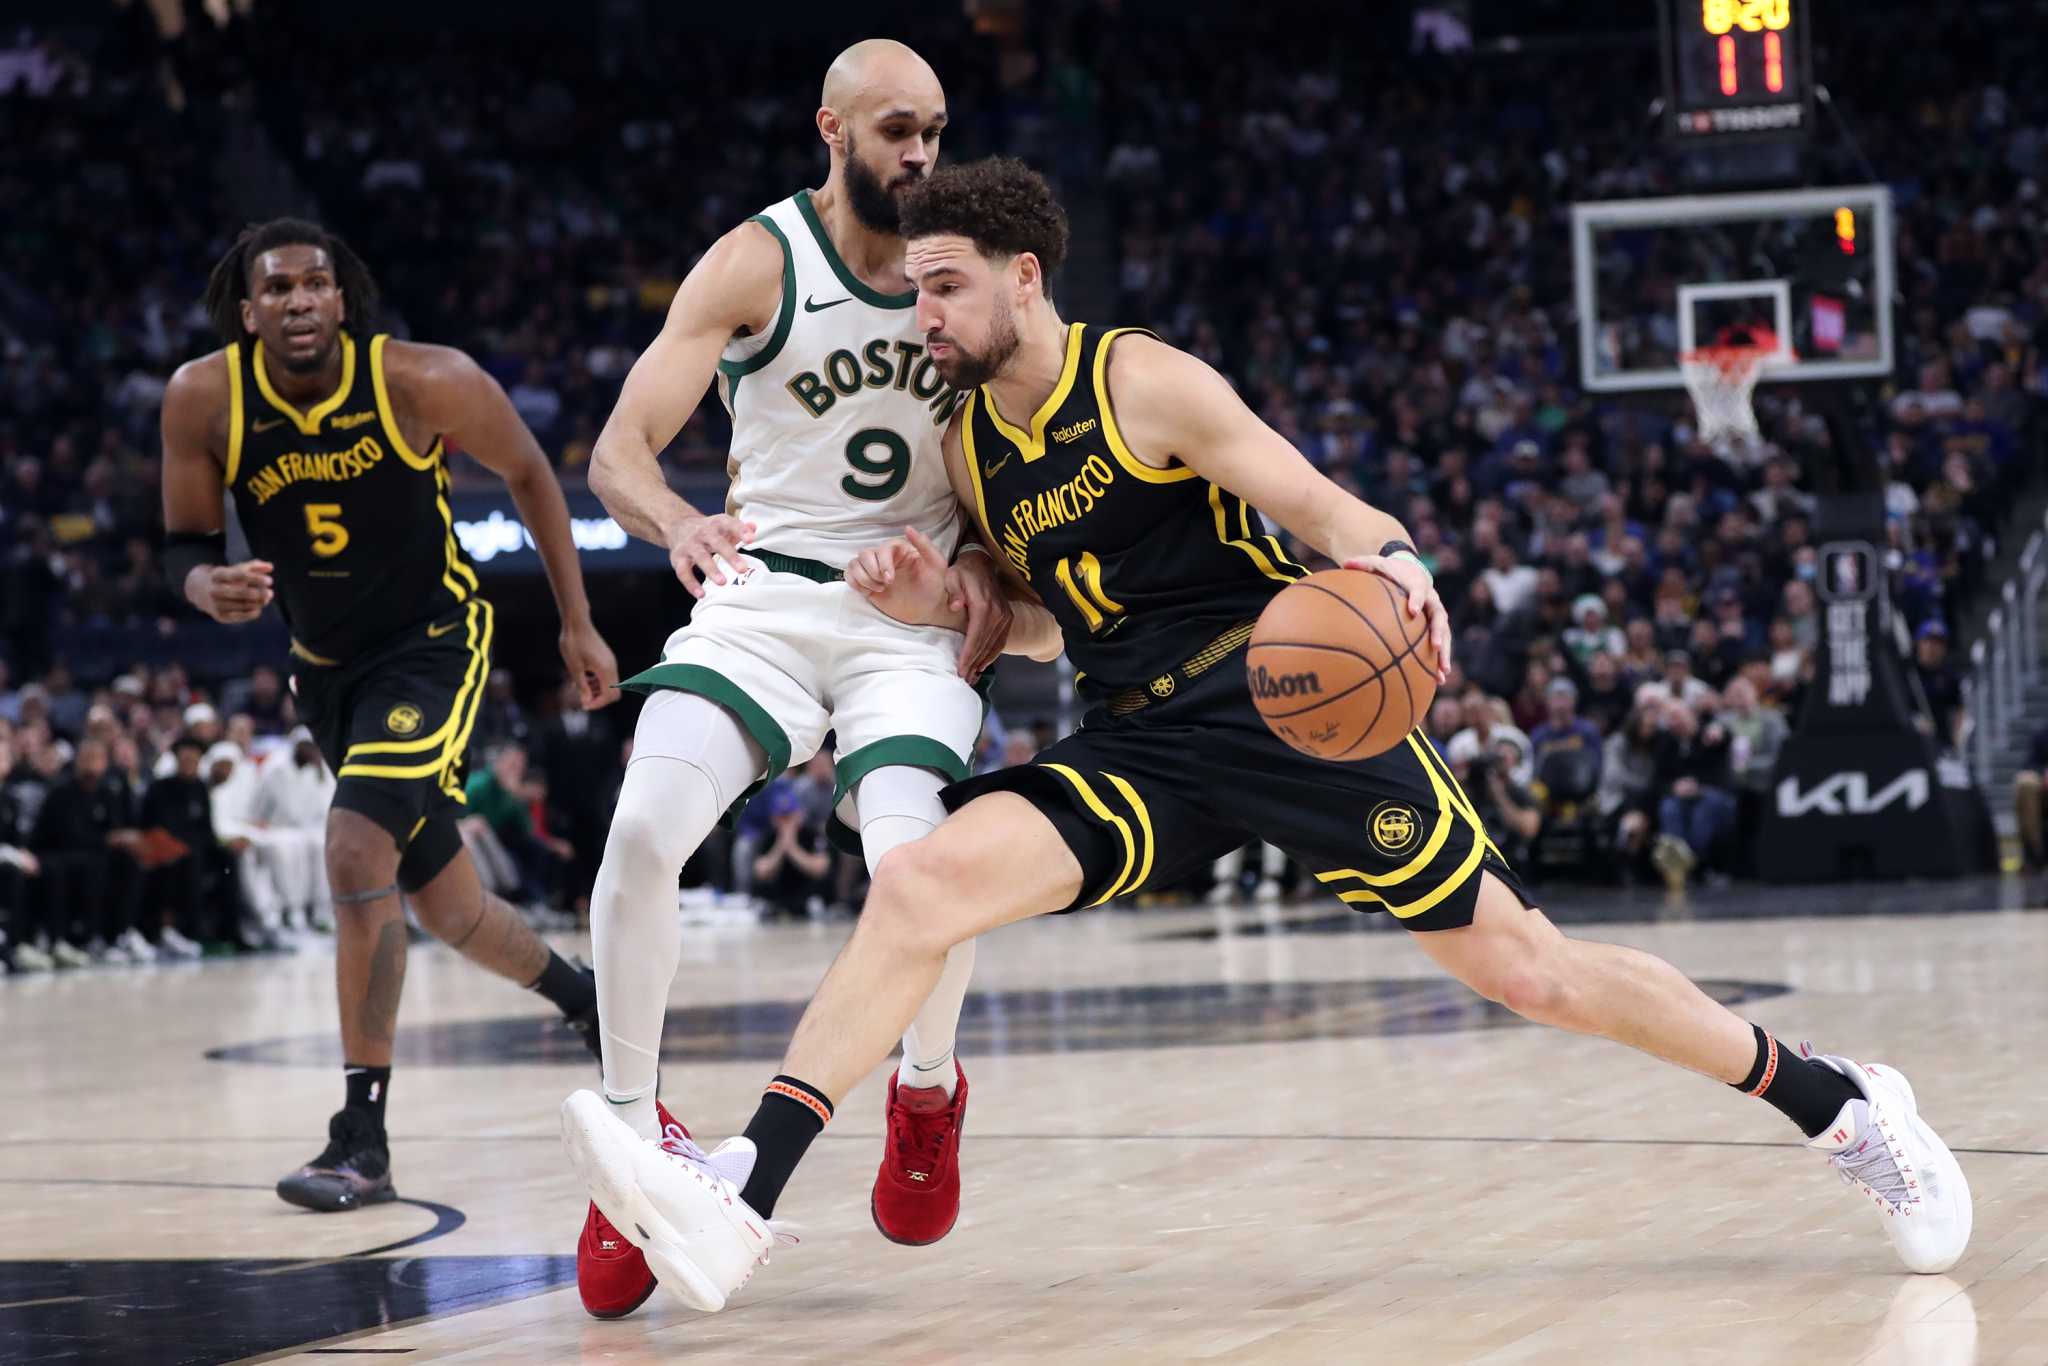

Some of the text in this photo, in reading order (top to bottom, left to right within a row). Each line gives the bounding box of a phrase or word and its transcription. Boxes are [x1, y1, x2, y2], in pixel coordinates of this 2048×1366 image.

[1718, 31, 1783, 96] 11
[1052, 417, 1096, 444] Rakuten
[248, 436, 383, 505] SAN FRANCISCO
[840, 427, 912, 502] 9
[1012, 454, 1114, 541] FRANCISCO
[304, 503, 349, 557] 5
[1055, 551, 1125, 633] 11
[1248, 664, 1323, 701] ilson
